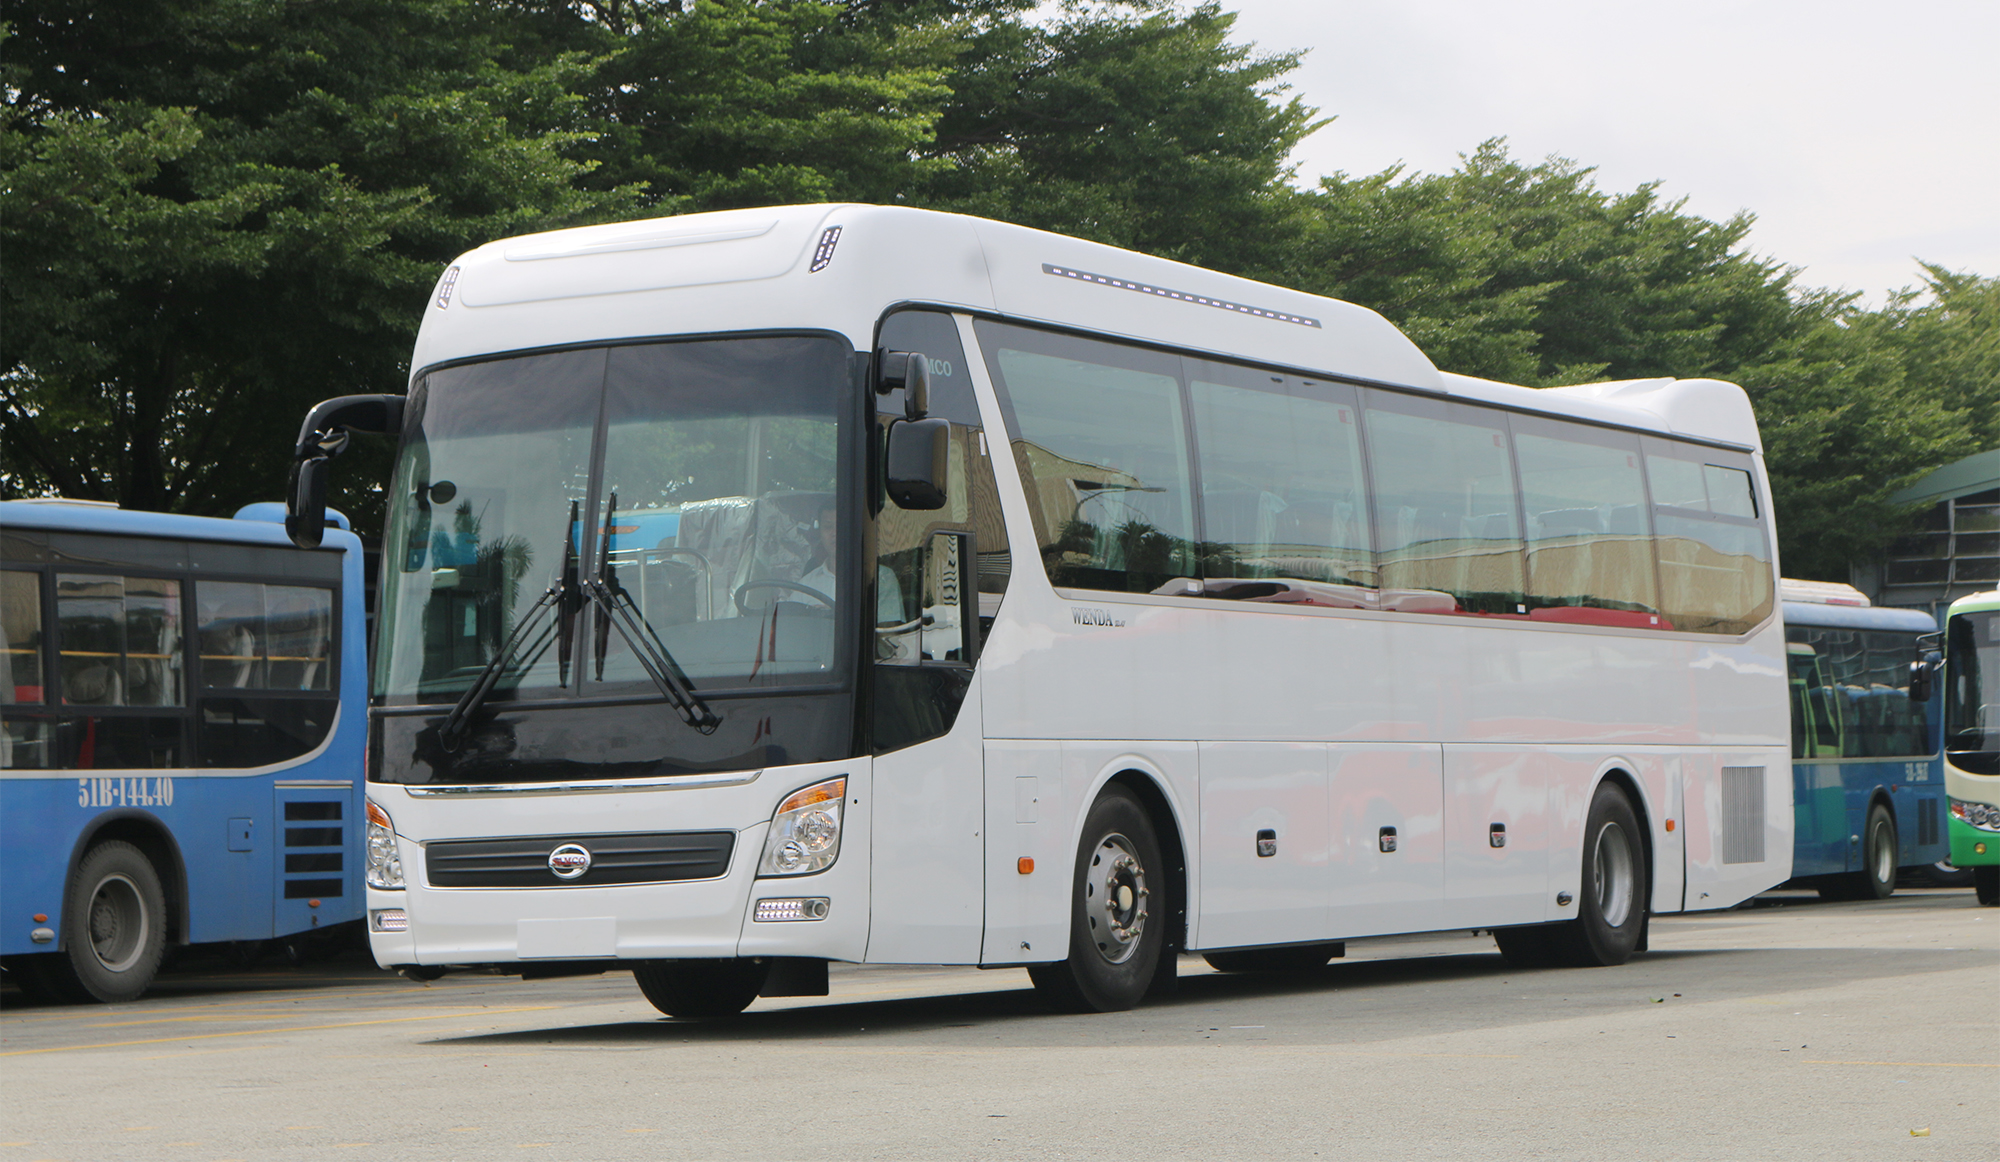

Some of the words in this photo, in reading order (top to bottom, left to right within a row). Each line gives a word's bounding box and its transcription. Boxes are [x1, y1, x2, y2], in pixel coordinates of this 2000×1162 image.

[926, 358, 952, 377] MCO
[1071, 606, 1113, 627] WENDA
[78, 777, 174, 808] 51B-144.40
